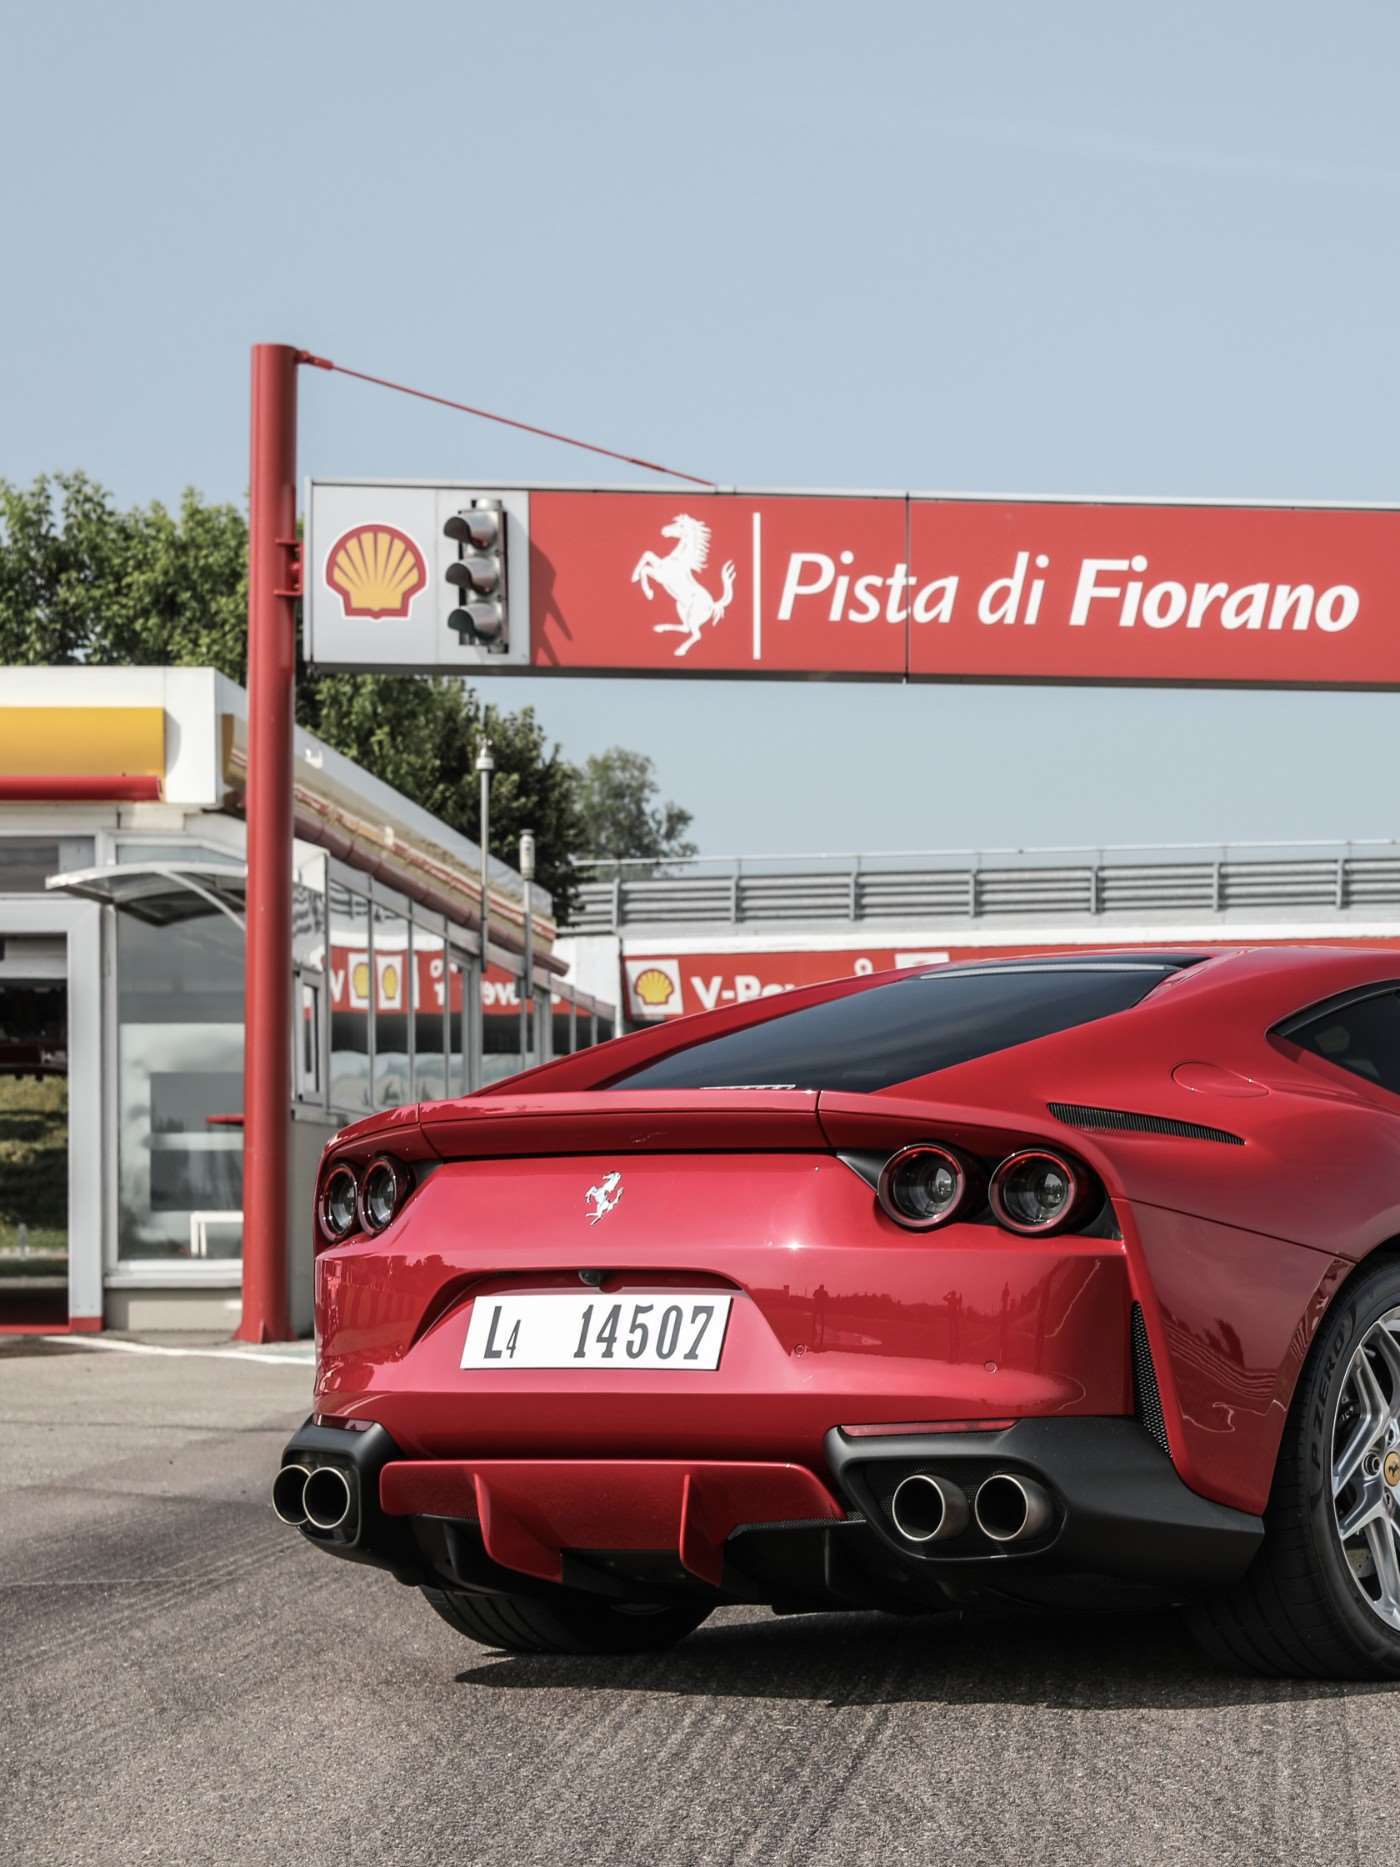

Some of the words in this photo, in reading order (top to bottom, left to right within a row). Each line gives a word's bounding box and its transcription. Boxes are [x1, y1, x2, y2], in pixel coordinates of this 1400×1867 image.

[777, 550, 960, 624] Pista
[977, 551, 1050, 625] di
[1069, 554, 1360, 632] Fiorano
[573, 1304, 715, 1360] 14507
